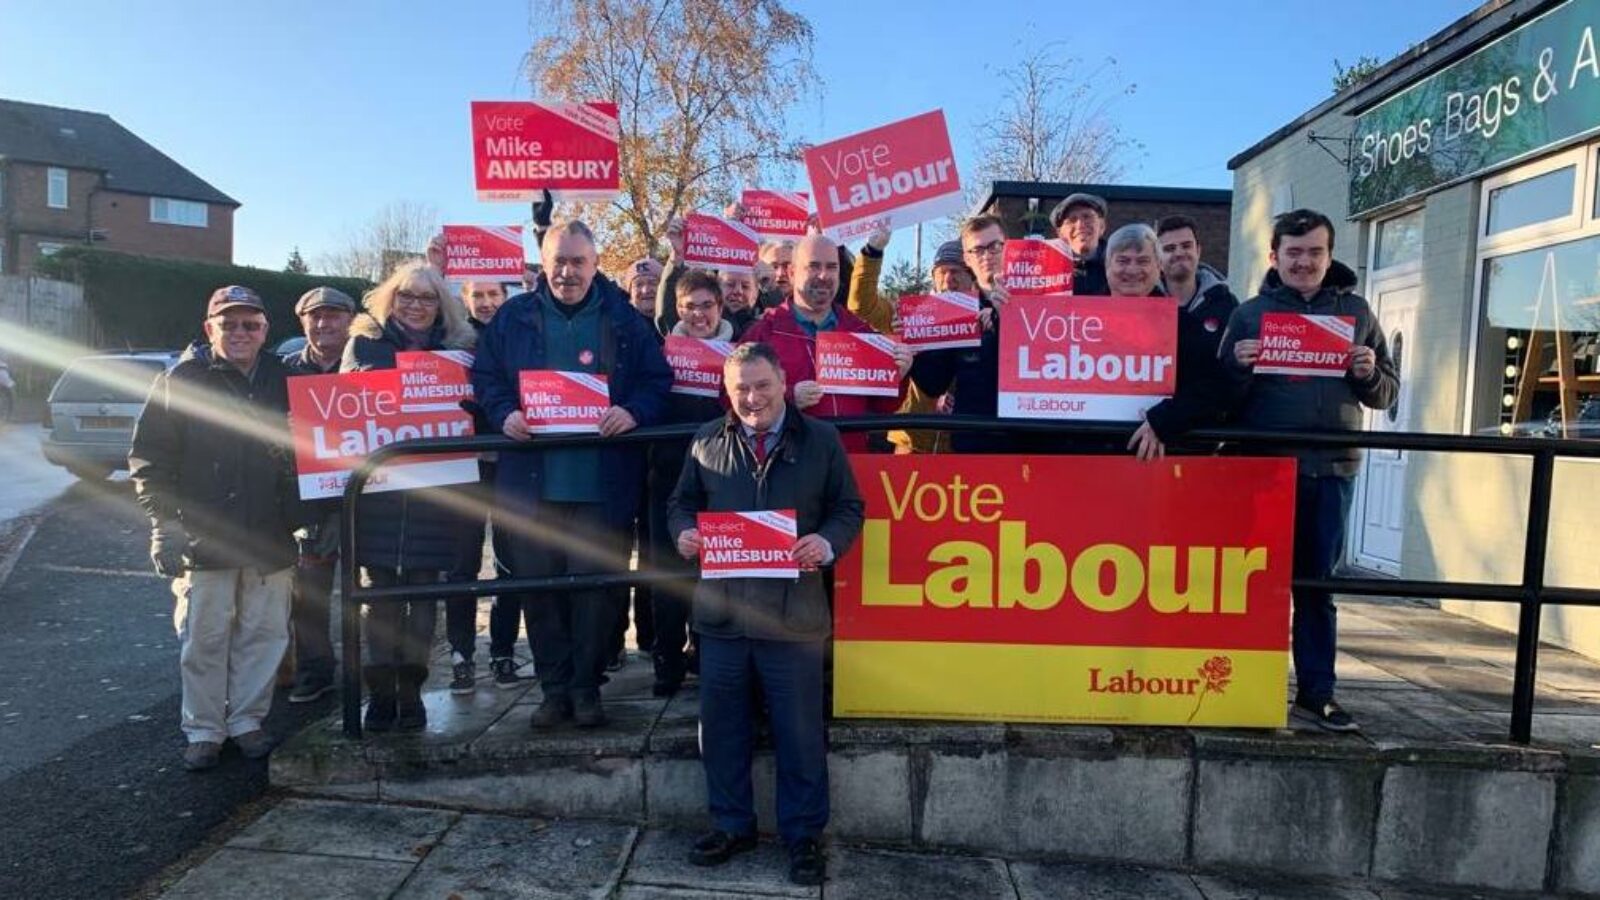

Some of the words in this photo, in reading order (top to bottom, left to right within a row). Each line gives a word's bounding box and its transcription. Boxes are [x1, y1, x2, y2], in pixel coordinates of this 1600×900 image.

[1359, 118, 1431, 177] Shoes
[1445, 76, 1520, 140] Bags
[1533, 48, 1558, 103] &
[484, 114, 524, 132] Vote
[486, 136, 542, 157] Mike
[486, 159, 613, 180] AMESBURY
[821, 143, 891, 180] Vote
[828, 157, 951, 213] Labour
[687, 231, 718, 245] Mike
[447, 244, 480, 256] Mike
[686, 245, 756, 261] AMESBURY
[447, 257, 523, 270] AMESBURY
[1007, 261, 1042, 275] Mike
[1006, 272, 1071, 289] AMESBURY
[903, 314, 935, 327] Mike
[1020, 307, 1103, 342] Vote
[904, 322, 977, 339] AMESBURY
[1264, 335, 1301, 350] Mike
[819, 353, 854, 366] Mike
[1018, 344, 1172, 382] Labour
[1260, 349, 1348, 365] AMESBURY
[401, 372, 438, 385] Mike
[819, 367, 897, 382] AMESBURY
[402, 384, 474, 399] AMESBUR
[524, 391, 562, 405] Mike
[308, 386, 397, 421] Vote
[1032, 397, 1086, 412] Labour
[526, 405, 608, 420] AMESBURY
[880, 469, 1004, 523] Vote
[703, 535, 744, 549] Mike
[704, 549, 794, 564] AMESBURY
[861, 518, 1268, 614] Labour
[1088, 668, 1201, 695] Labour
